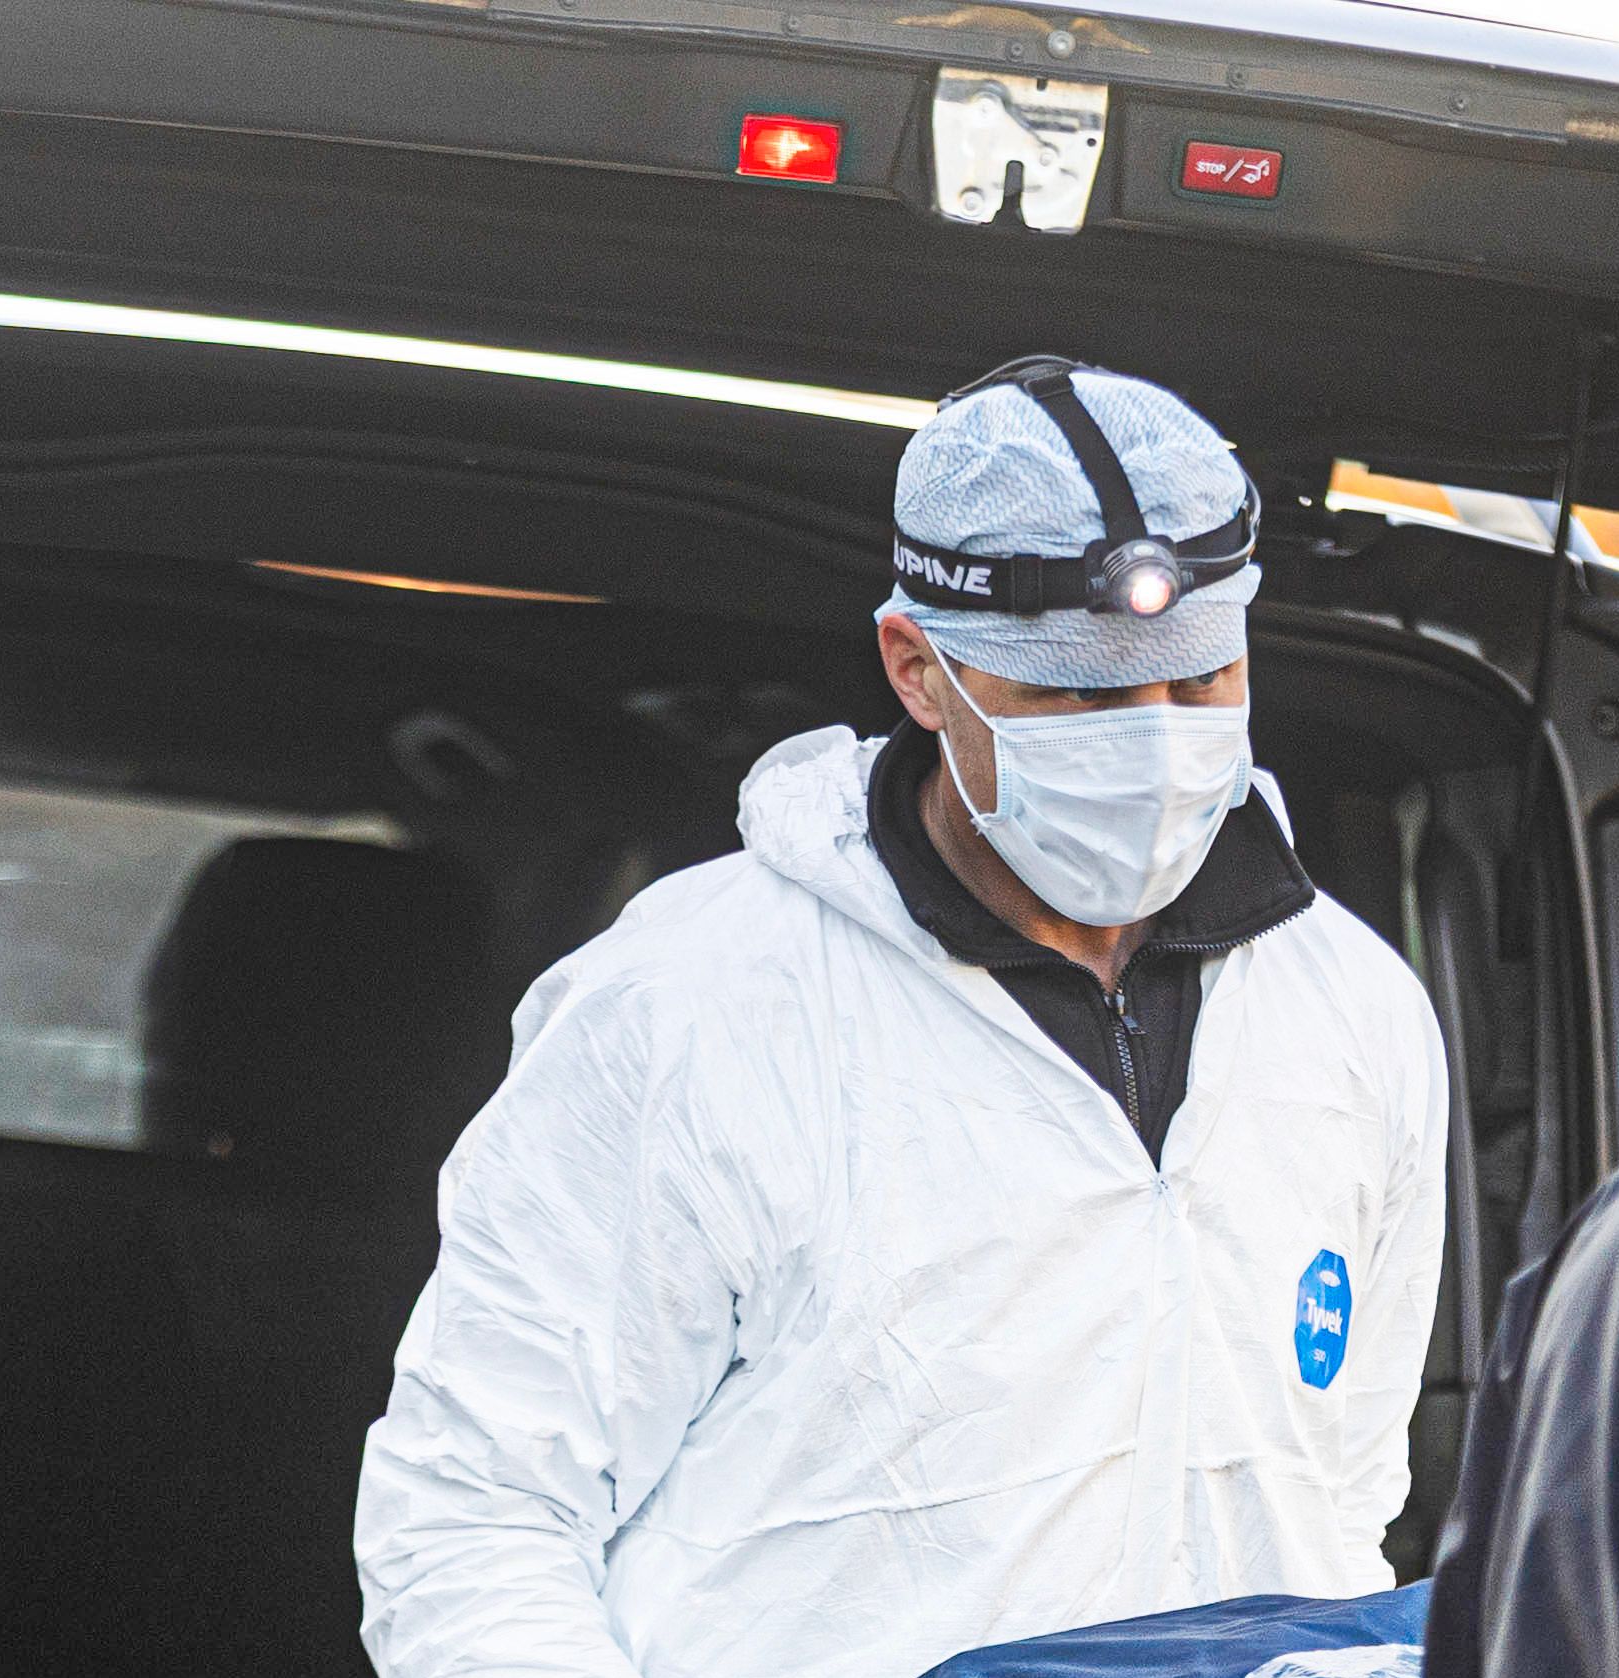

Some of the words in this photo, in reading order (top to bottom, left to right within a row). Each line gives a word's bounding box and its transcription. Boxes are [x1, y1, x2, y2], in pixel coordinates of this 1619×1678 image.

[1195, 160, 1227, 175] STOP
[893, 533, 993, 596] UPINE
[1306, 1296, 1343, 1337] Tyvek
